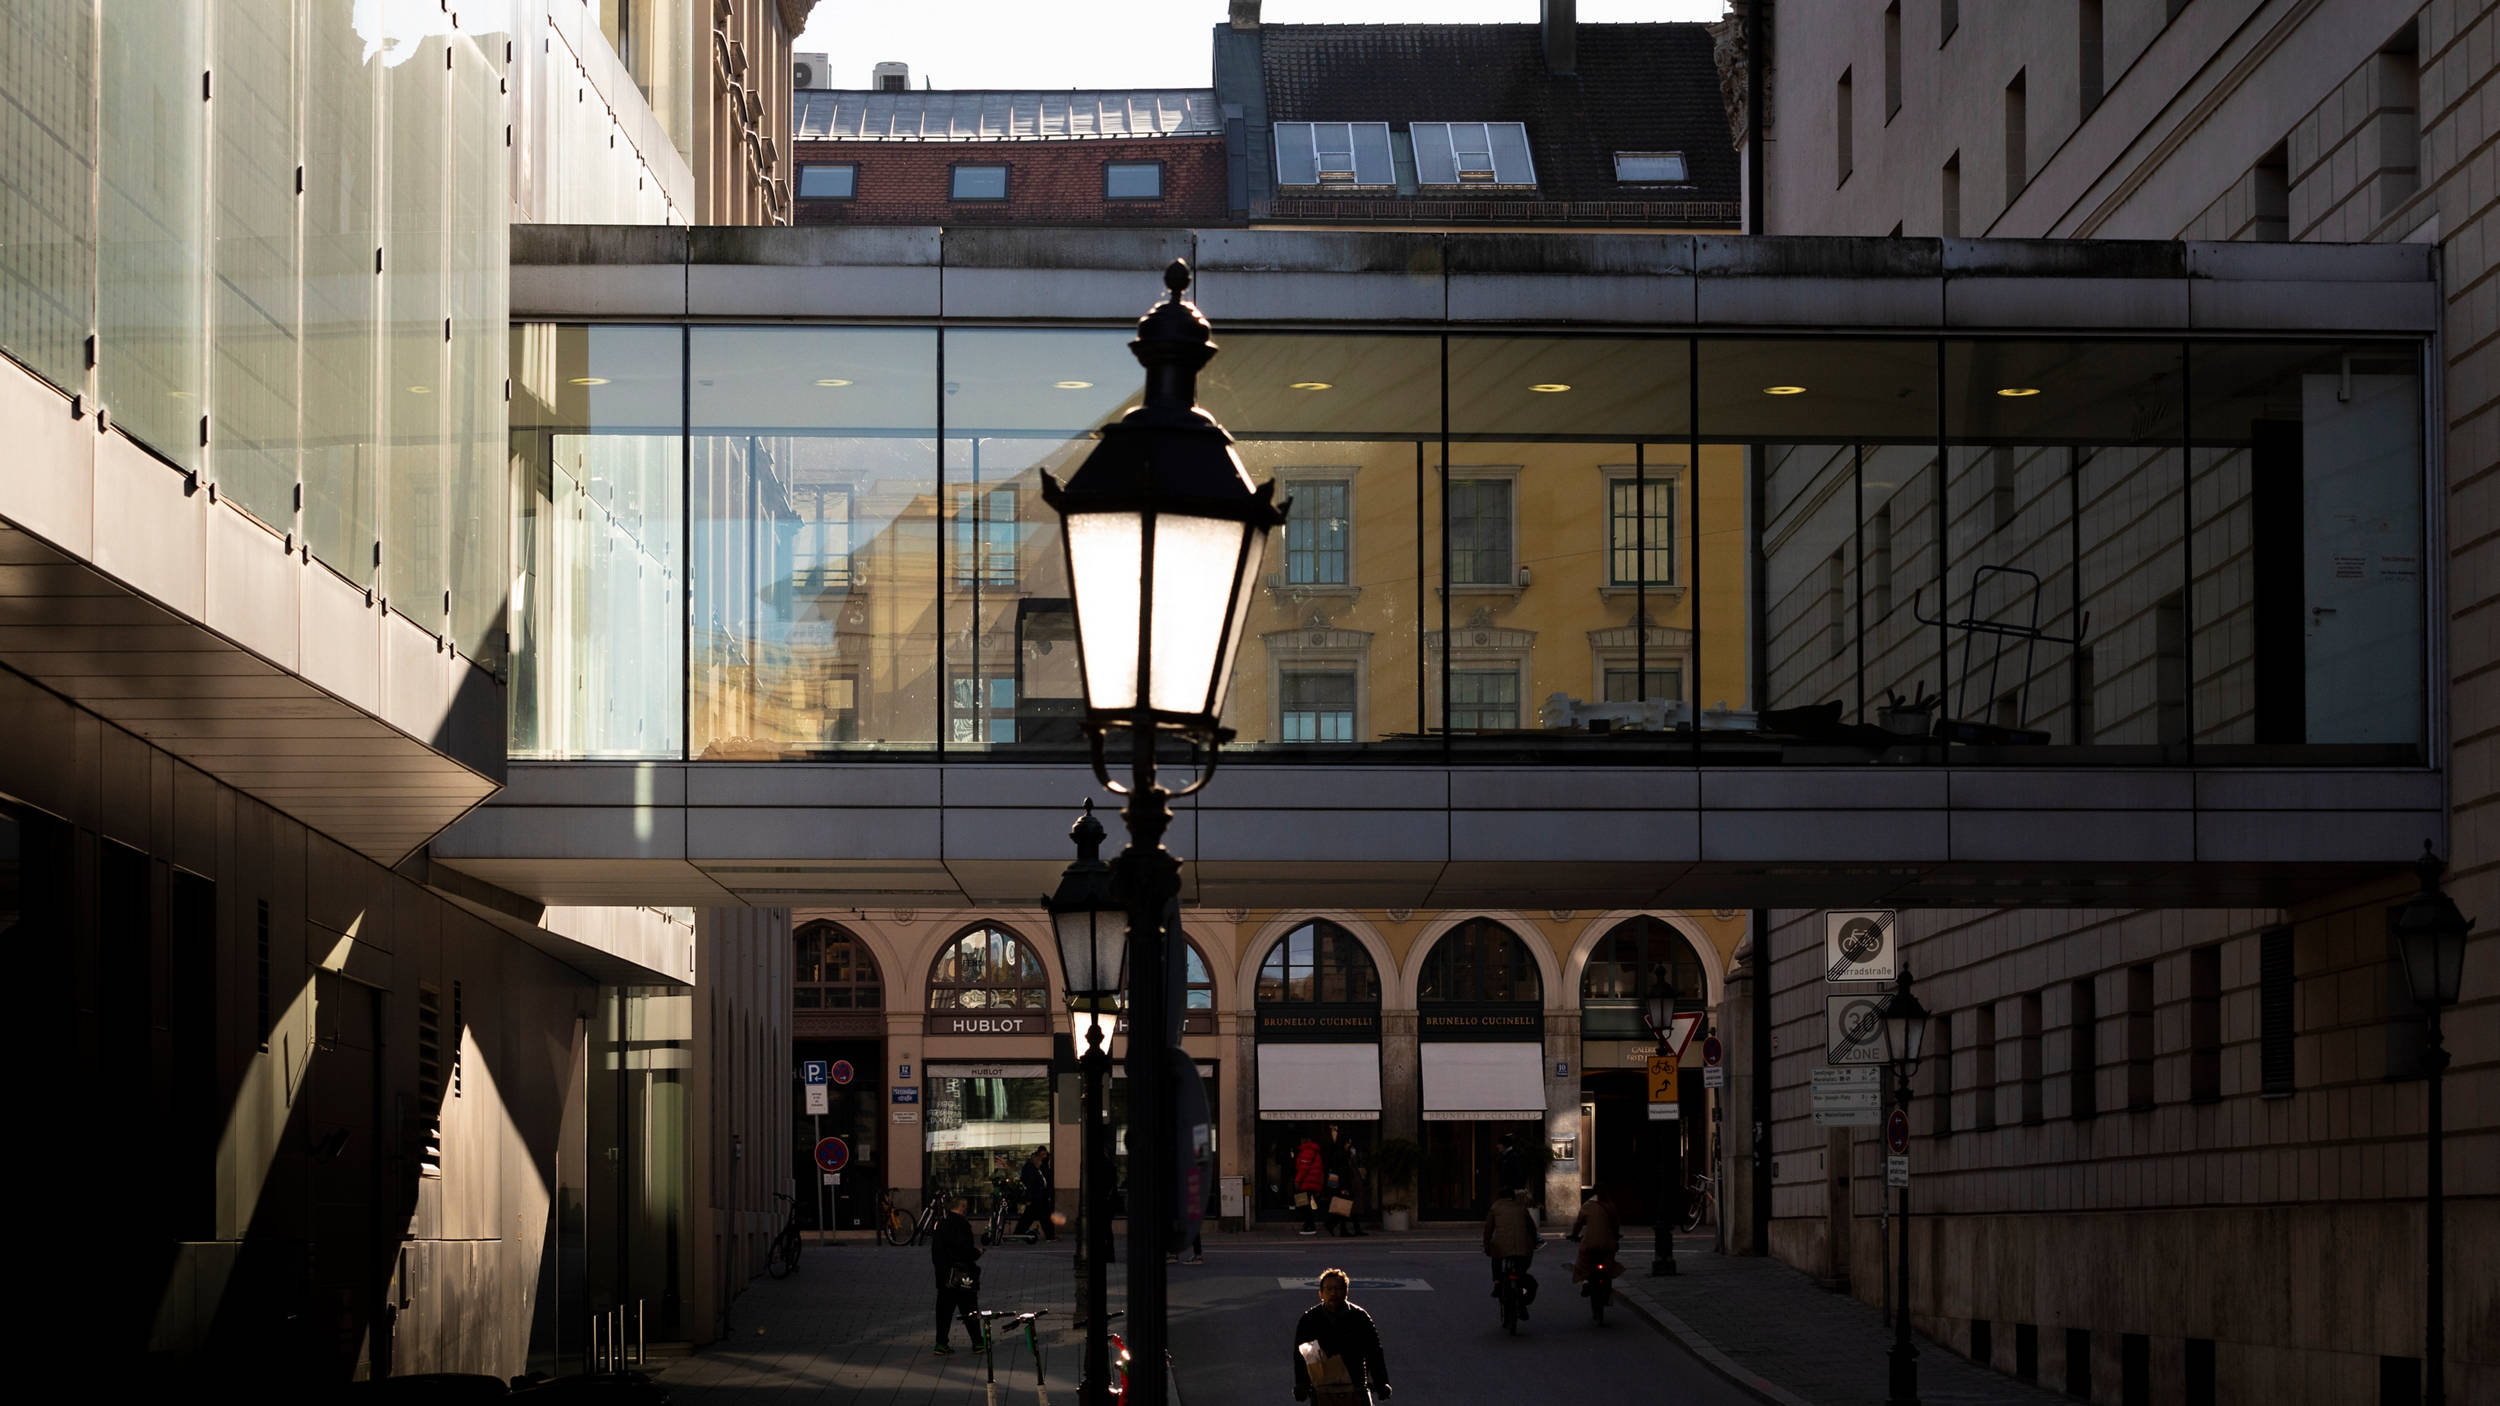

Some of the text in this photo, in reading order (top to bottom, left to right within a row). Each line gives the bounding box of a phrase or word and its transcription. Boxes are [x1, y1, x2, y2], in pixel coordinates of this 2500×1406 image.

[953, 1019, 1023, 1032] HUBLOT
[1264, 1016, 1373, 1026] BRUNELLO CUCINELLI
[1426, 1016, 1535, 1025] BRUNELLO CUCINELLI
[1845, 1048, 1880, 1060] ZONE
[808, 1064, 820, 1082] P
[970, 1068, 1003, 1076] HUBLOT
